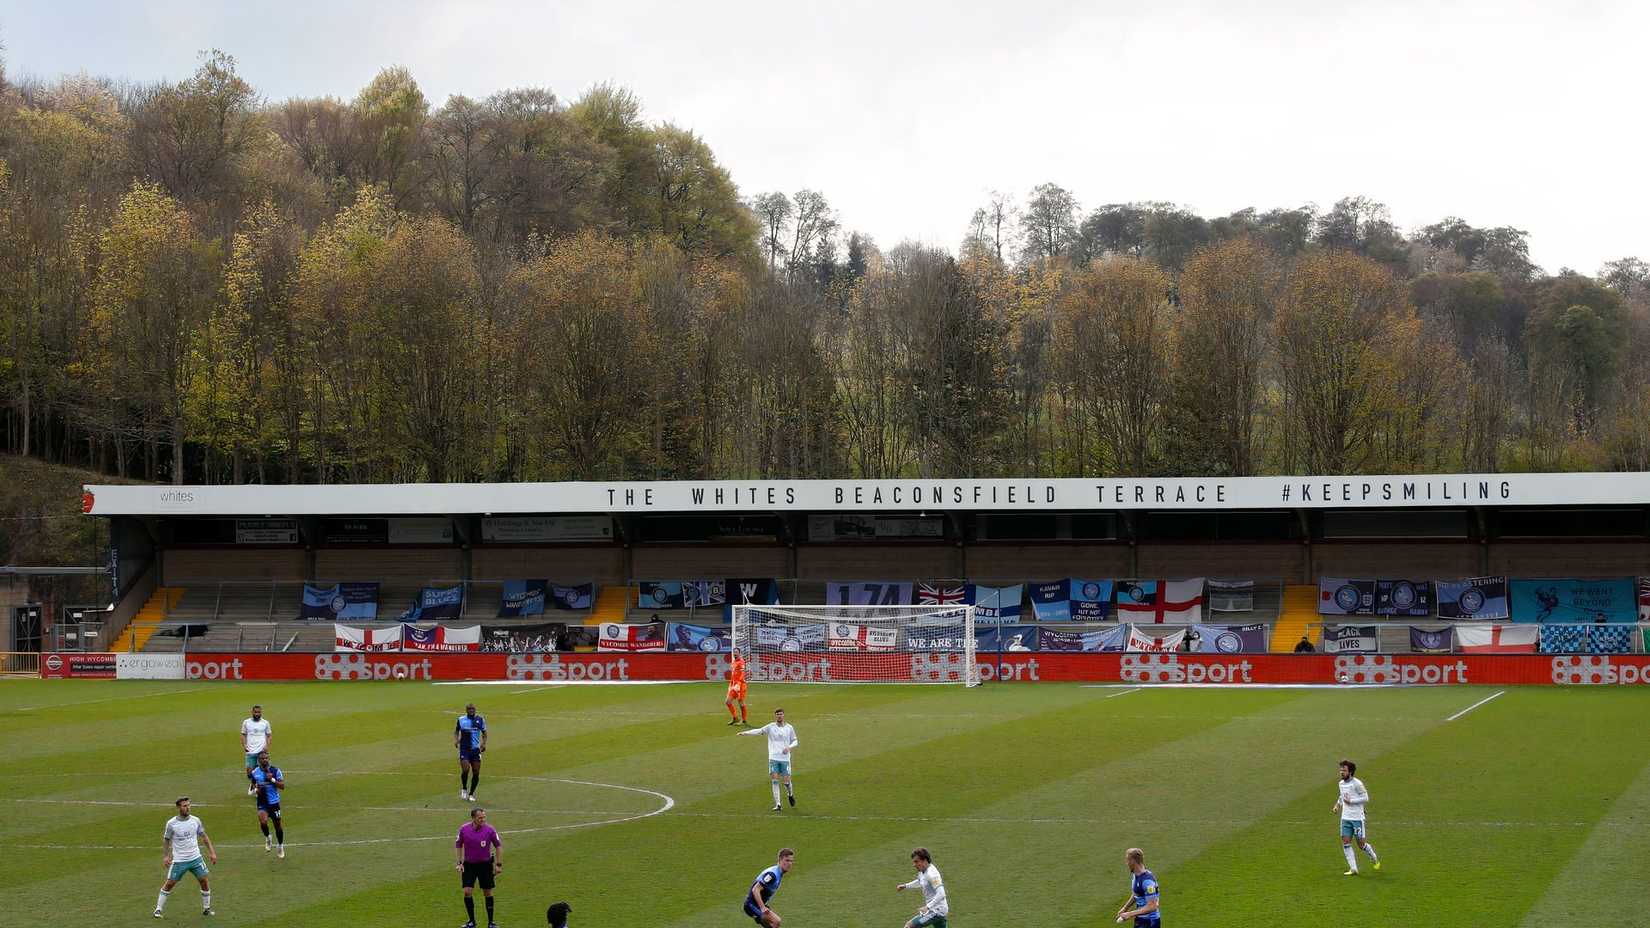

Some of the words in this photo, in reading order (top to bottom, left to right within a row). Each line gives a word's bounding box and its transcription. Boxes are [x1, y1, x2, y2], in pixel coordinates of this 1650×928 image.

[160, 490, 194, 502] whites
[607, 488, 653, 506] THE
[691, 487, 795, 505] WHITES
[834, 486, 1055, 504] BEACONSFIELD
[1095, 485, 1225, 503] TERRACE
[1281, 481, 1510, 502] #KEEPSMILING
[908, 638, 926, 648] WE
[930, 638, 951, 648] ARE
[1339, 639, 1360, 649] LIVES
